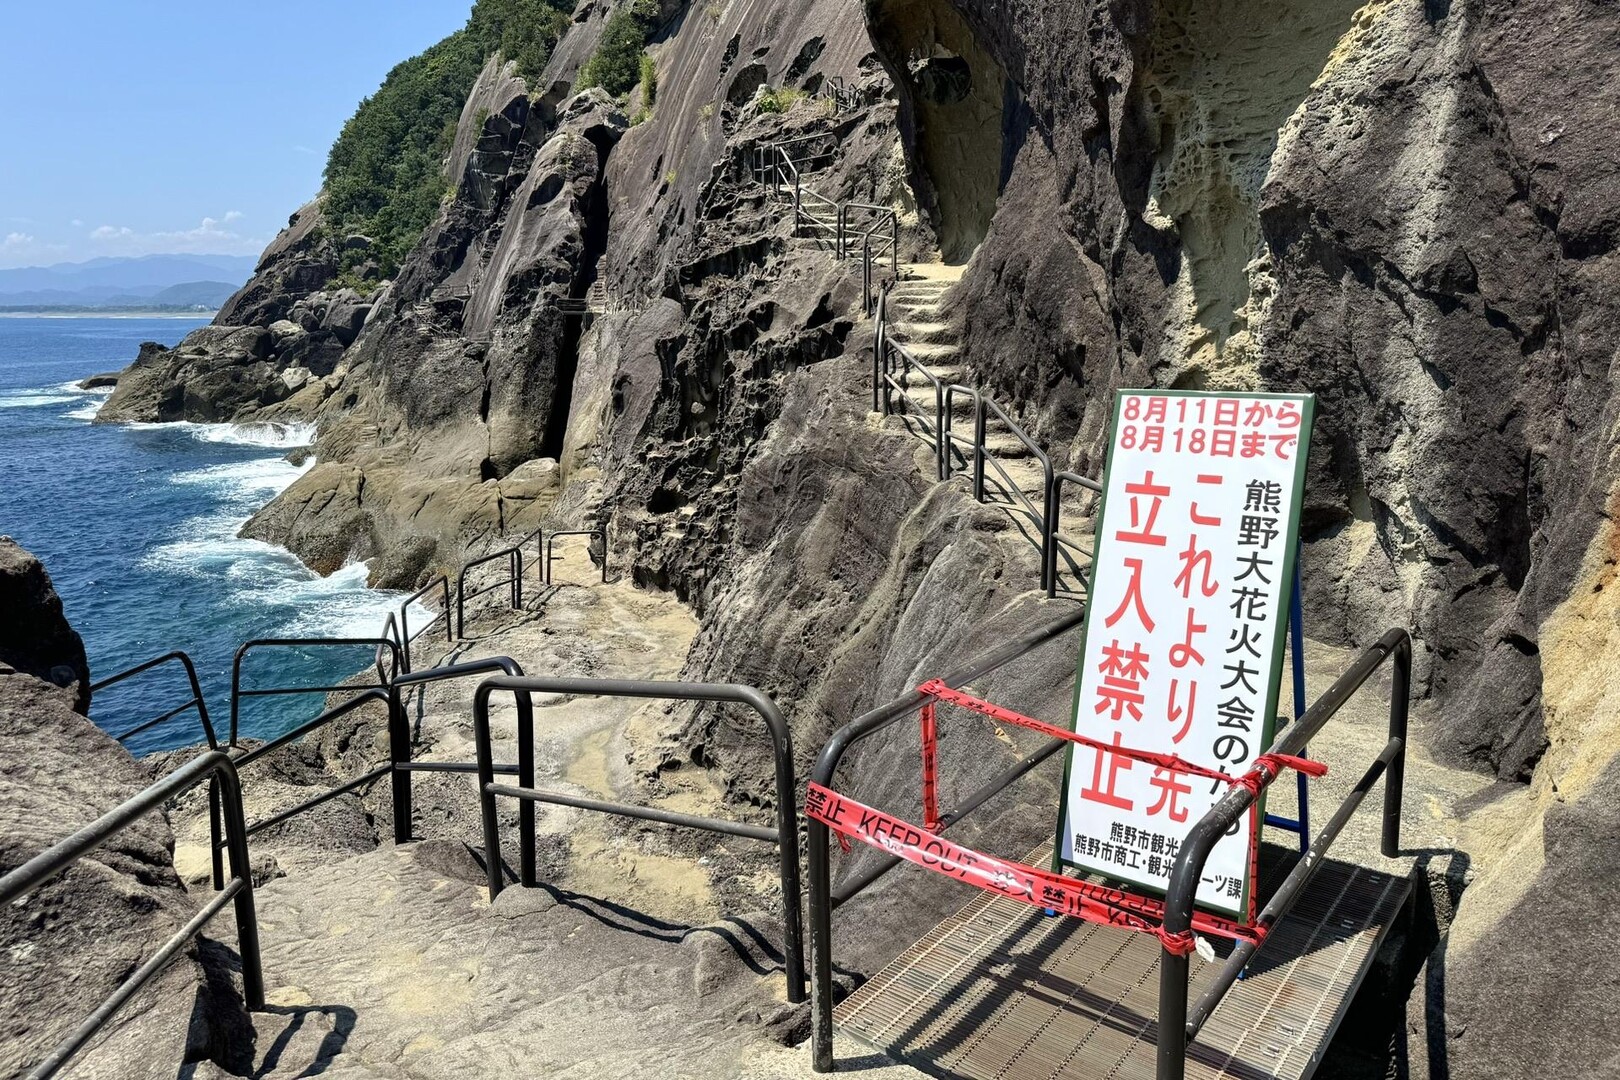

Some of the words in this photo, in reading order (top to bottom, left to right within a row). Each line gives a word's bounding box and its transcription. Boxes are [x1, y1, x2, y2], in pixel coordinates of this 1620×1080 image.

[1120, 424, 1298, 460] 8月18日まで
[1123, 396, 1302, 429] 8月11日から
[1080, 470, 1171, 811] 立入禁止
[1145, 473, 1224, 823] これより先
[806, 787, 846, 826] 禁止
[922, 840, 978, 877] OUT
[1110, 821, 1185, 858] 熊野市観光
[1073, 833, 1243, 900] 熊野市商工・観光ーツ課
